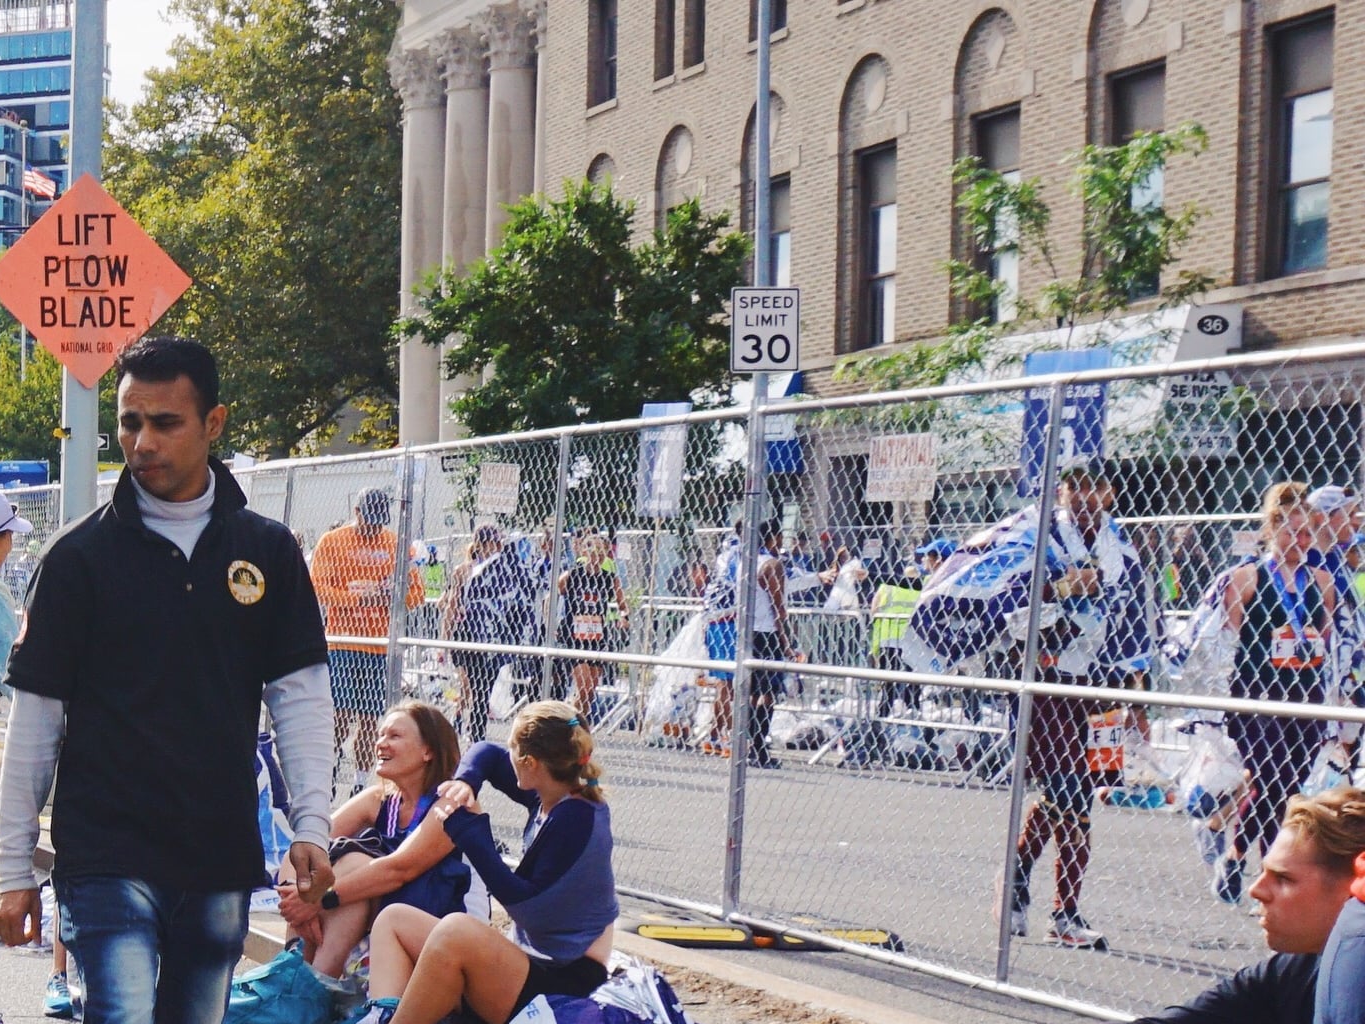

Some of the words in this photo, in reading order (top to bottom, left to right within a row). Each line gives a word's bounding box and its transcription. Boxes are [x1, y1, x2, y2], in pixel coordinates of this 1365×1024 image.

[57, 214, 116, 246] LIFT
[44, 254, 129, 287] PLOW
[40, 296, 136, 328] BLADE
[739, 296, 793, 309] SPEED
[745, 314, 788, 327] LIMIT
[1202, 319, 1223, 332] 36
[60, 342, 93, 354] NATIONAL
[96, 342, 114, 354] GRID
[741, 334, 791, 364] 30
